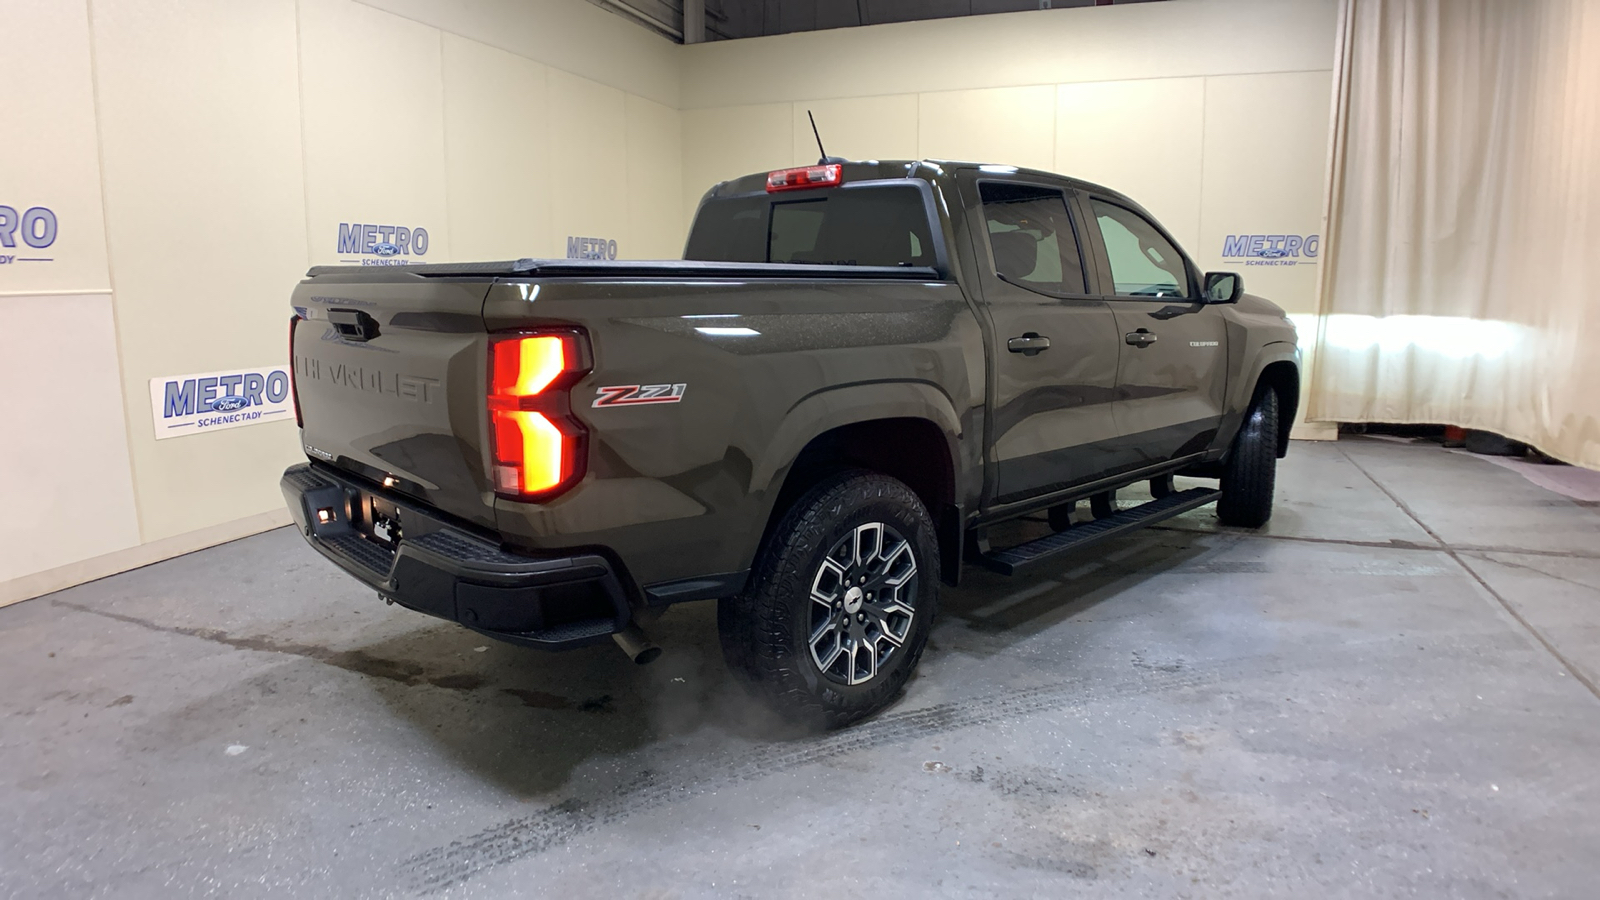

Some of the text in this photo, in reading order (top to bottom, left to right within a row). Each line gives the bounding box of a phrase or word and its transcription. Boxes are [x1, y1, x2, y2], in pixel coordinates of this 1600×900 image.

[337, 223, 429, 256] METRO
[567, 236, 618, 260] METRO
[1222, 235, 1319, 257] METRO
[163, 370, 289, 418] METRO
[218, 398, 242, 411] Ford
[197, 411, 263, 428] SCHENECTADY
